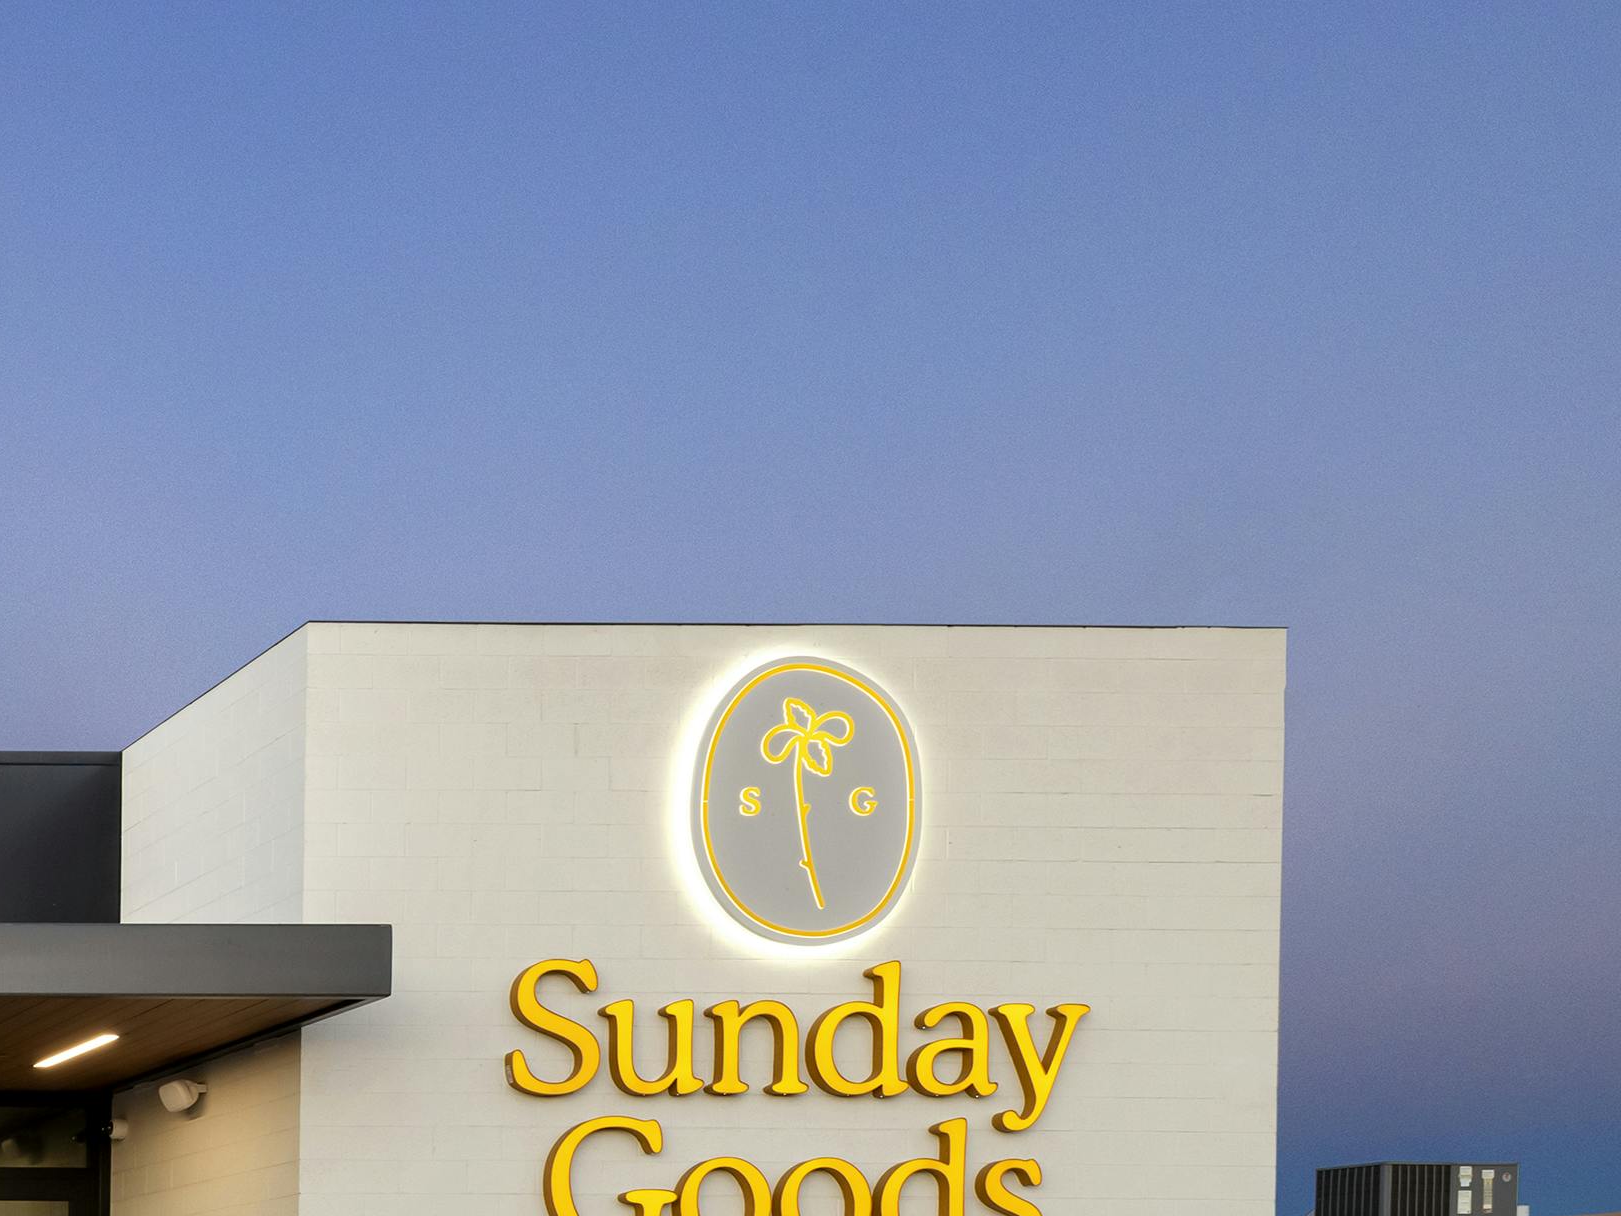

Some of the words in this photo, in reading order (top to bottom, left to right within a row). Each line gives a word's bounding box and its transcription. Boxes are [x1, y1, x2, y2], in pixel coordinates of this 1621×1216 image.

[739, 786, 762, 816] S
[848, 786, 878, 816] G
[504, 959, 1090, 1132] Sunday
